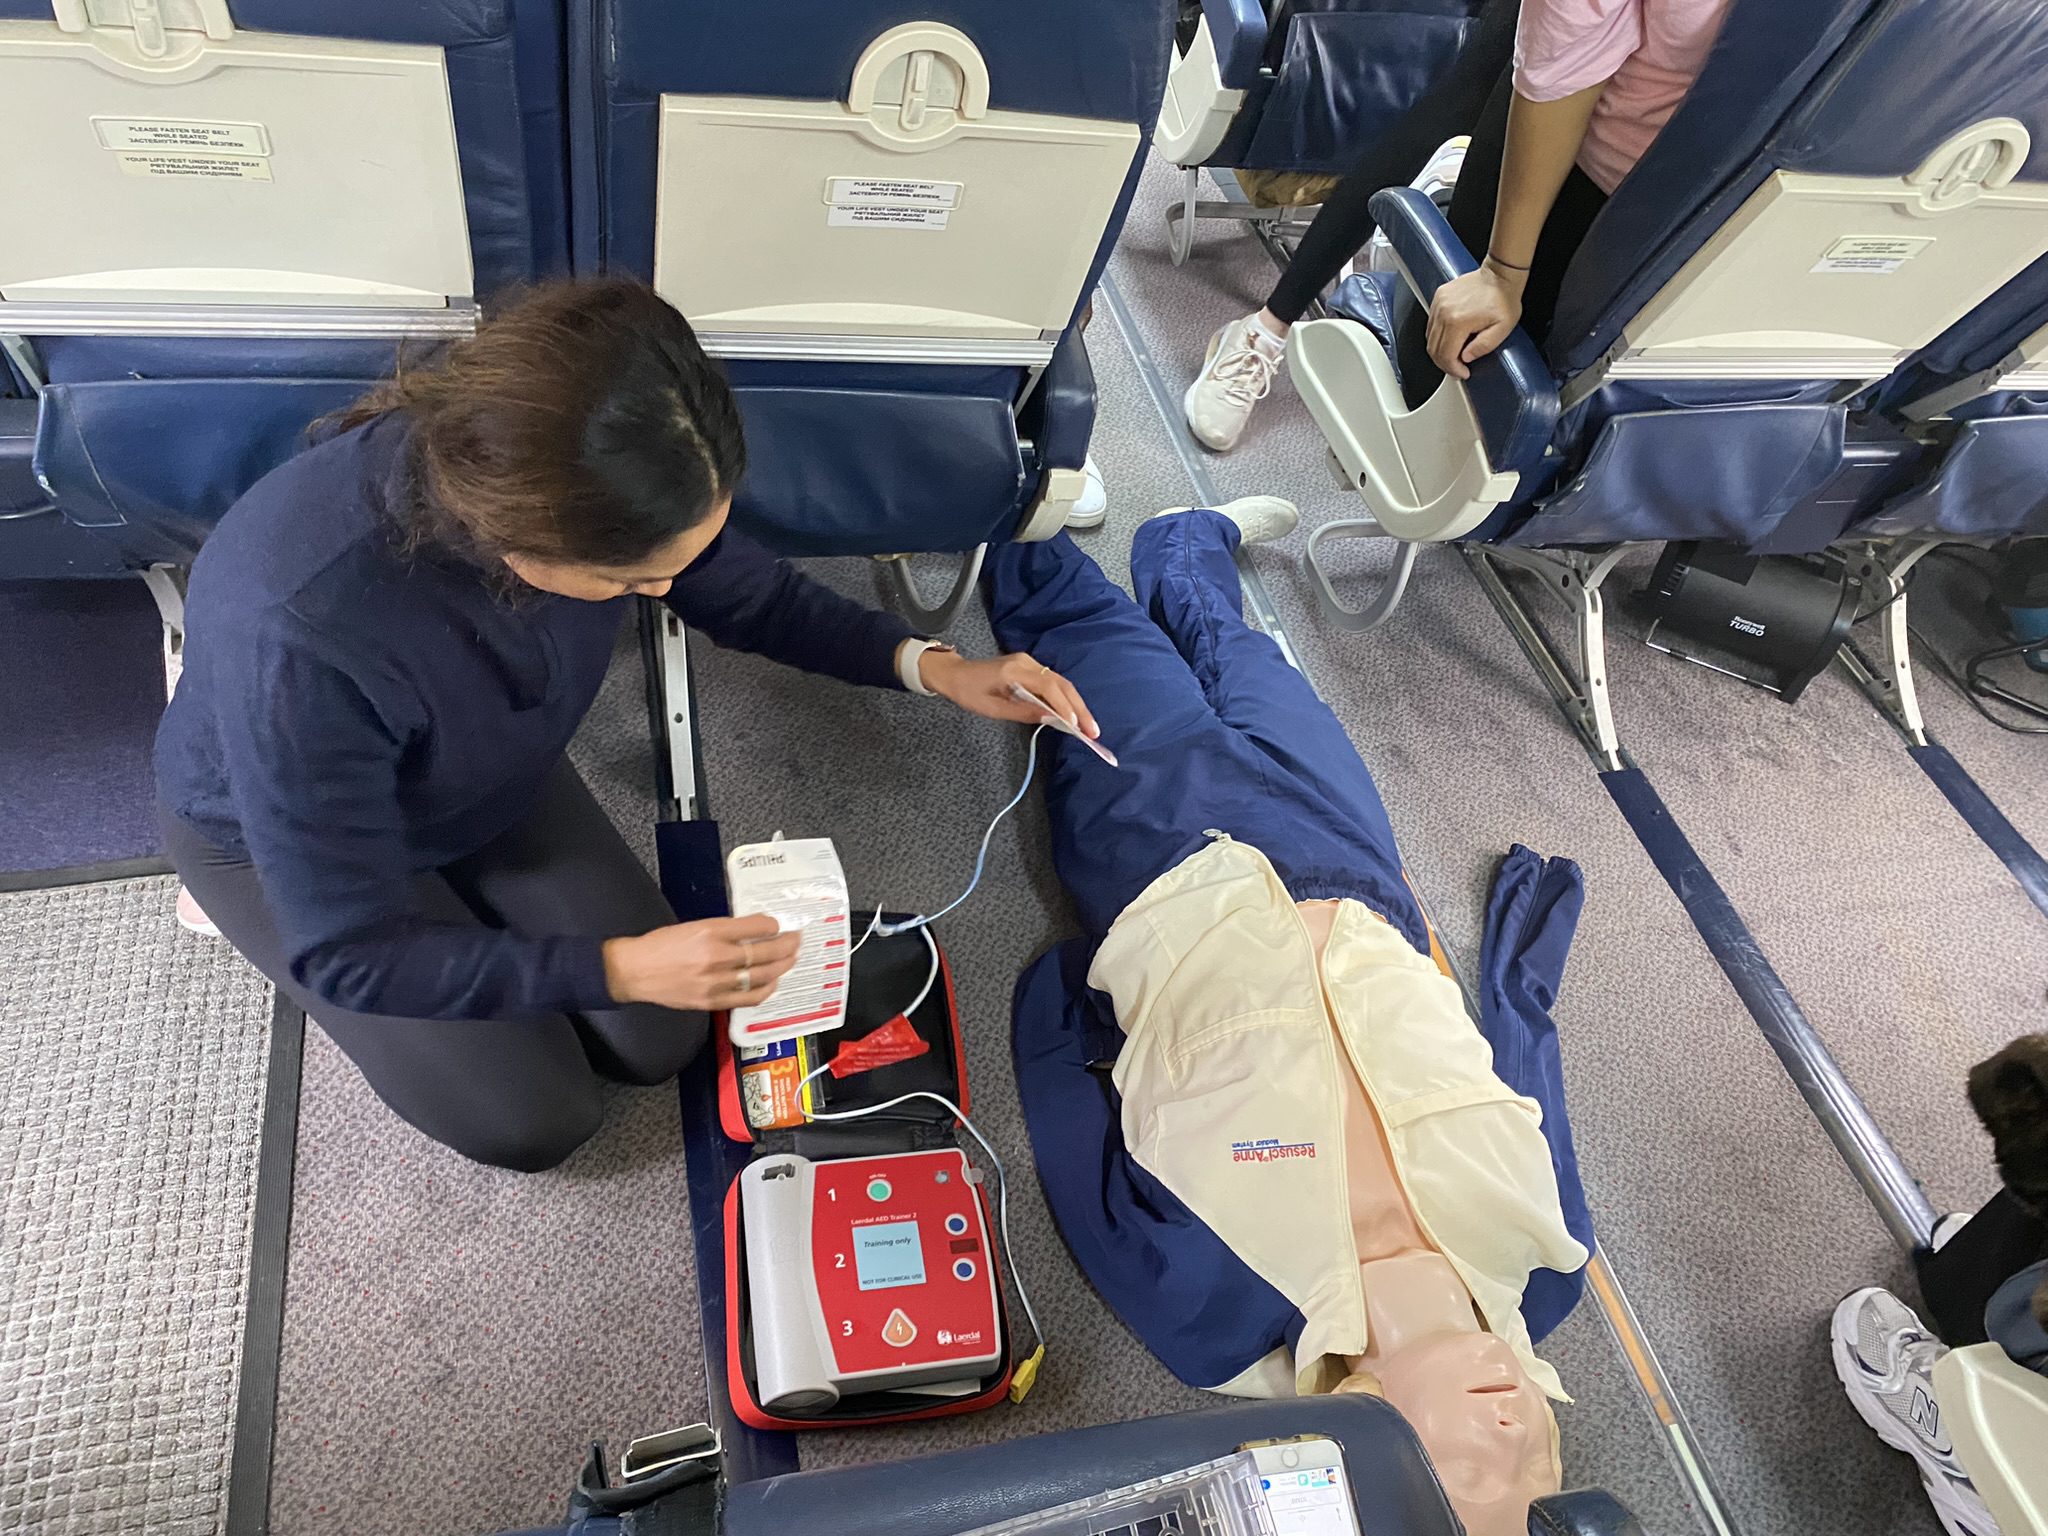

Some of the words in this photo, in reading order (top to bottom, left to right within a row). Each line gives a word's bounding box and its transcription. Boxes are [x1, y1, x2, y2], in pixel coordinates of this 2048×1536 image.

[1730, 620, 1764, 636] TURBO
[769, 1060, 794, 1075] 3
[1233, 1150, 1263, 1162] Anne
[828, 1189, 836, 1201] 1
[835, 1254, 846, 1268] 2
[842, 1320, 853, 1335] 3
[954, 1331, 980, 1343] Laerdal
